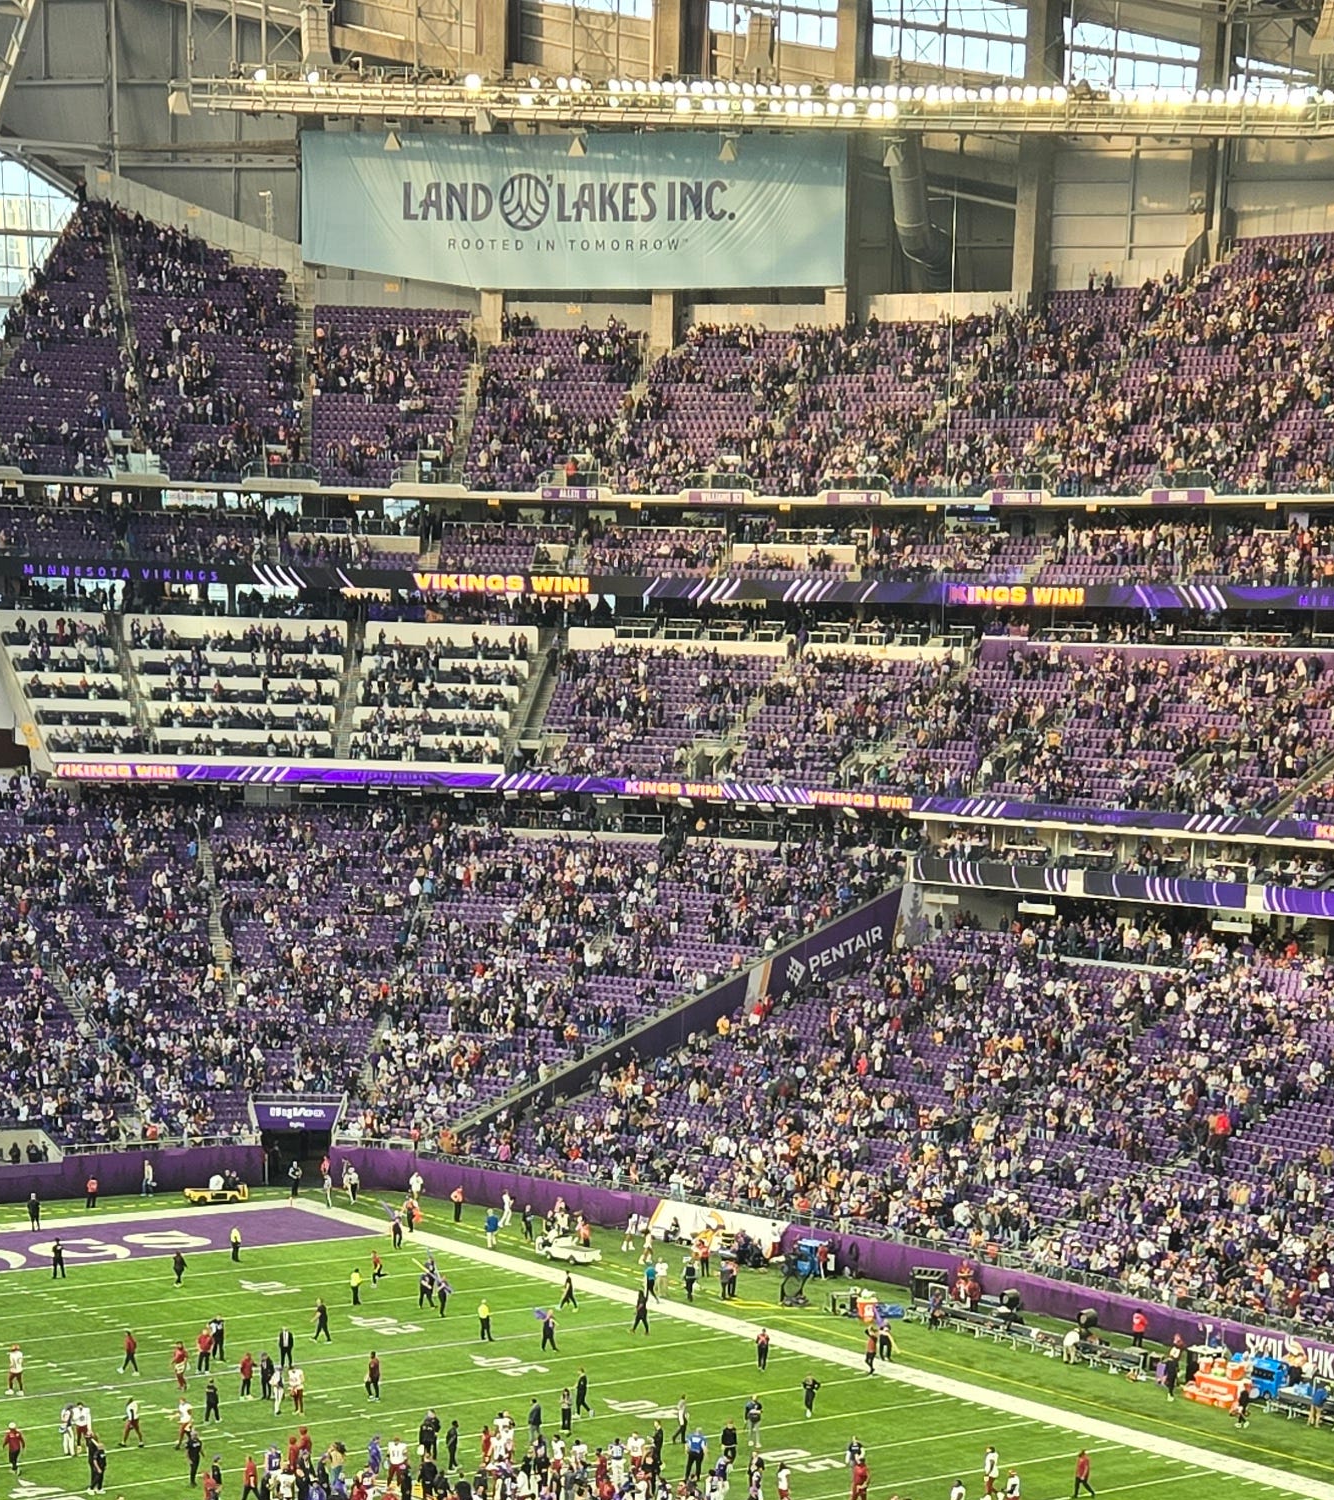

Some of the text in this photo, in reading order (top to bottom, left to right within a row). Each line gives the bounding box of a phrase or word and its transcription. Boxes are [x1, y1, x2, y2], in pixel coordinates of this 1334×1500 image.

[402, 181, 491, 222] LAND
[667, 180, 737, 222] INC.
[448, 238, 680, 252] ROOTED IN TOMORROW
[23, 564, 220, 582] MINNESOTA VIKINGS
[414, 573, 590, 594] VIKINGS WIN!
[1032, 587, 1085, 606] WIN!
[807, 788, 913, 811] VIKINGS WIN!
[807, 925, 884, 974] PENTAIR
